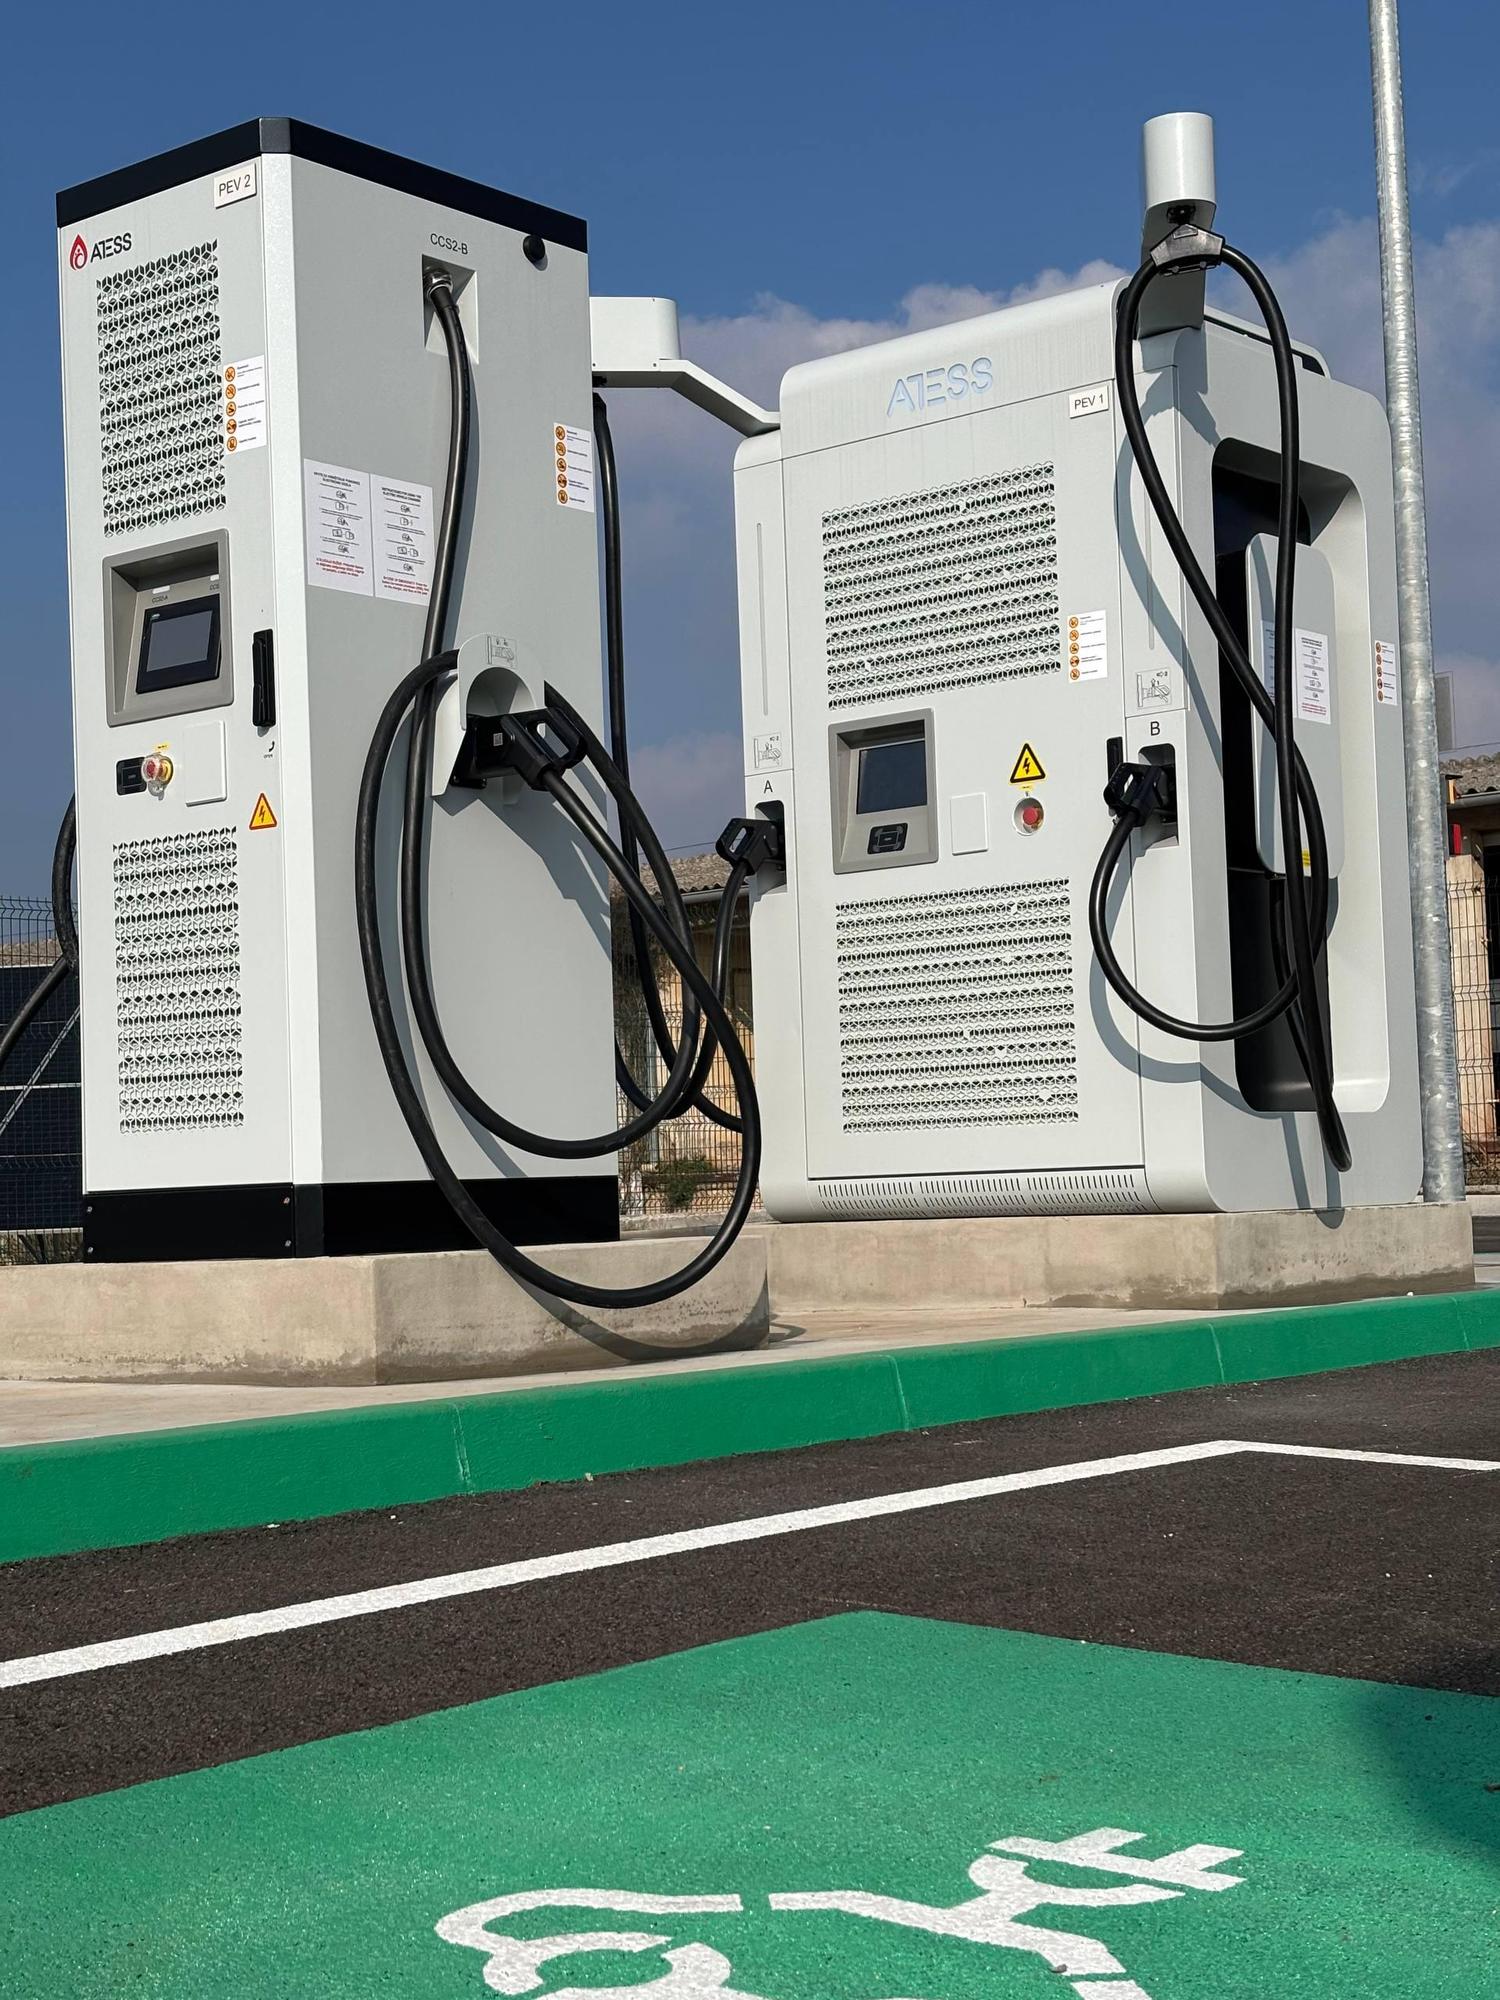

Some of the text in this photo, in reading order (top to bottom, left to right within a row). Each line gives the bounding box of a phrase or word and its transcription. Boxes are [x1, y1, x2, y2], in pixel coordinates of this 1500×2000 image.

[219, 174, 251, 197] PEV 2
[90, 232, 132, 263] ATESS
[430, 233, 468, 255] CCS2-B
[886, 356, 993, 417] ATESS
[1074, 393, 1103, 410] PEV 1
[1150, 720, 1161, 736] B
[763, 779, 773, 794] A
